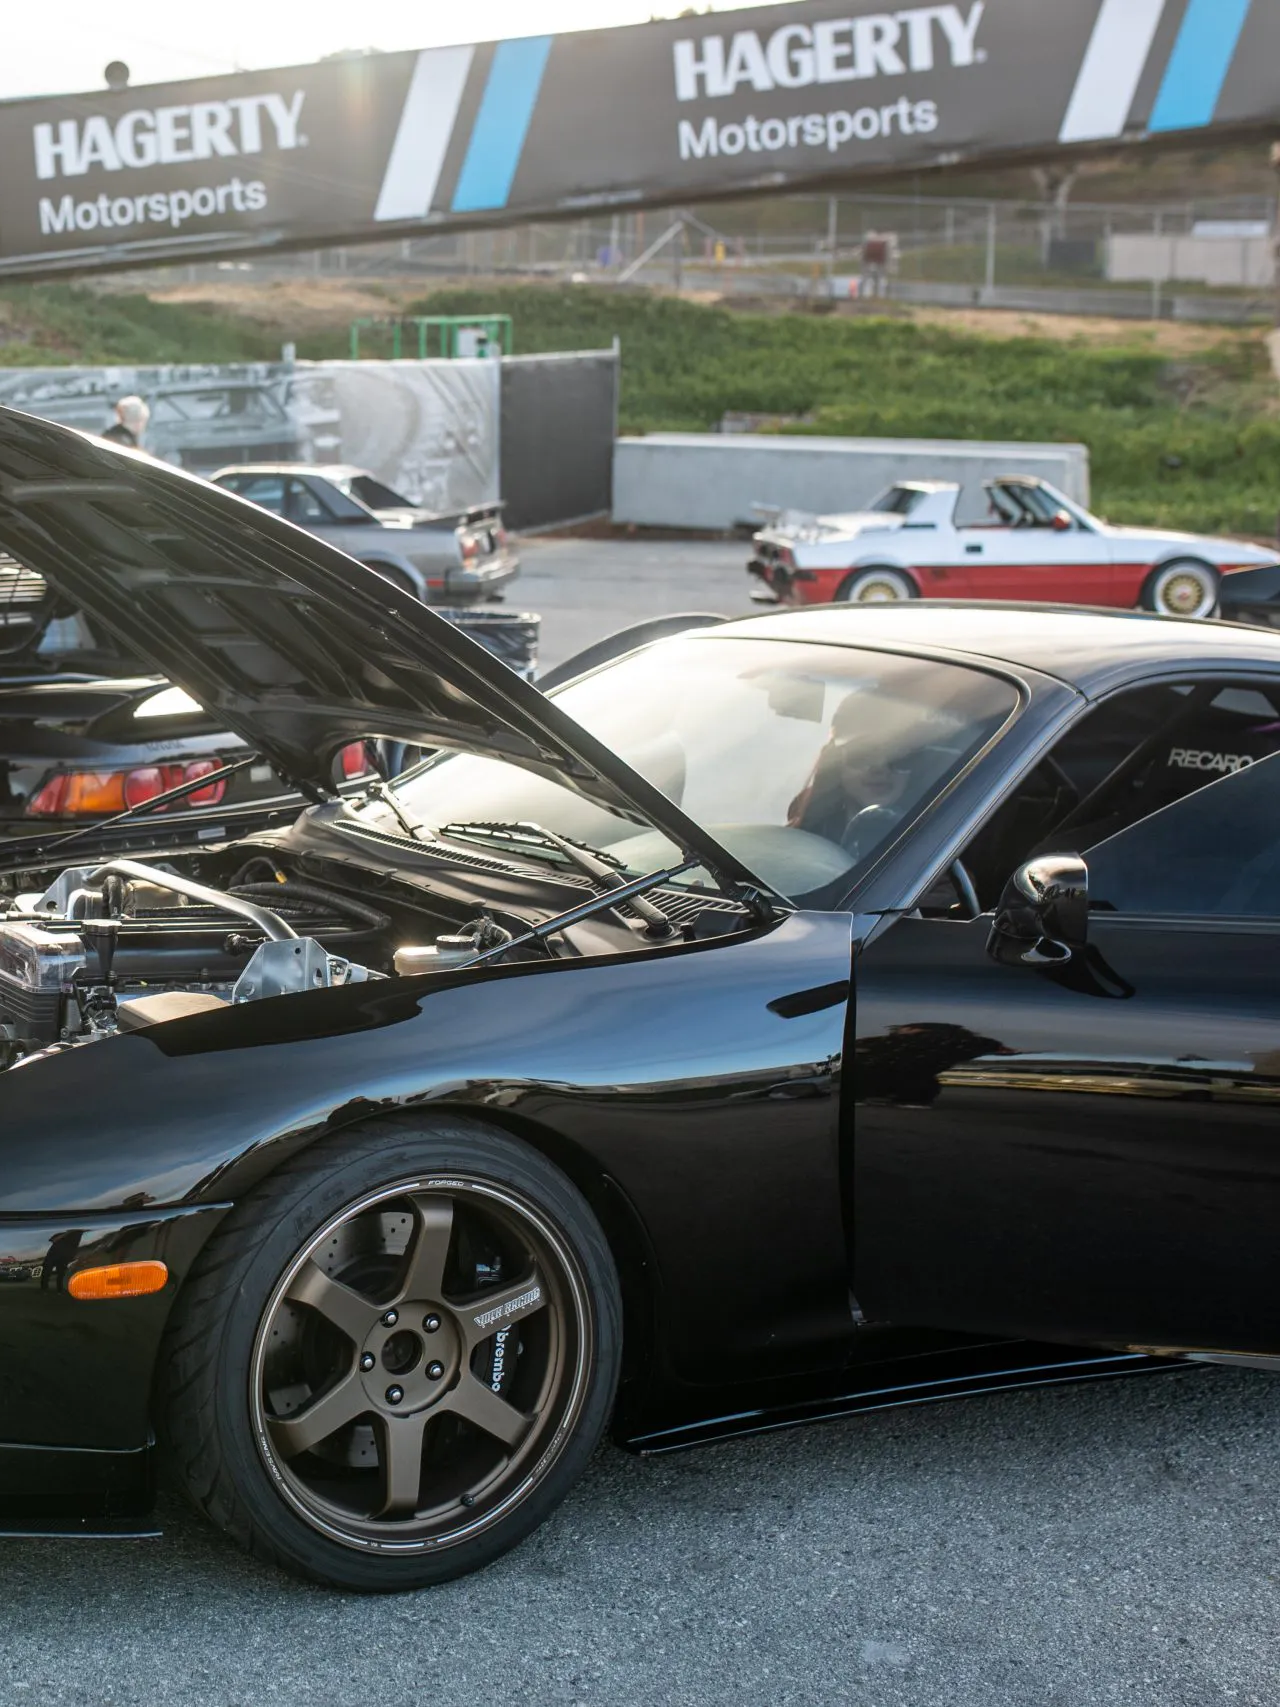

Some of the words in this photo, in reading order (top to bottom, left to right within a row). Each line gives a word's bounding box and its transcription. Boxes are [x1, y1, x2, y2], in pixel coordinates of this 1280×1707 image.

[674, 1, 984, 101] HAGERTY
[33, 90, 305, 179] HAGERTY
[678, 97, 939, 160] Motorsports
[38, 177, 268, 234] Motorsports
[491, 1331, 509, 1392] brembo
